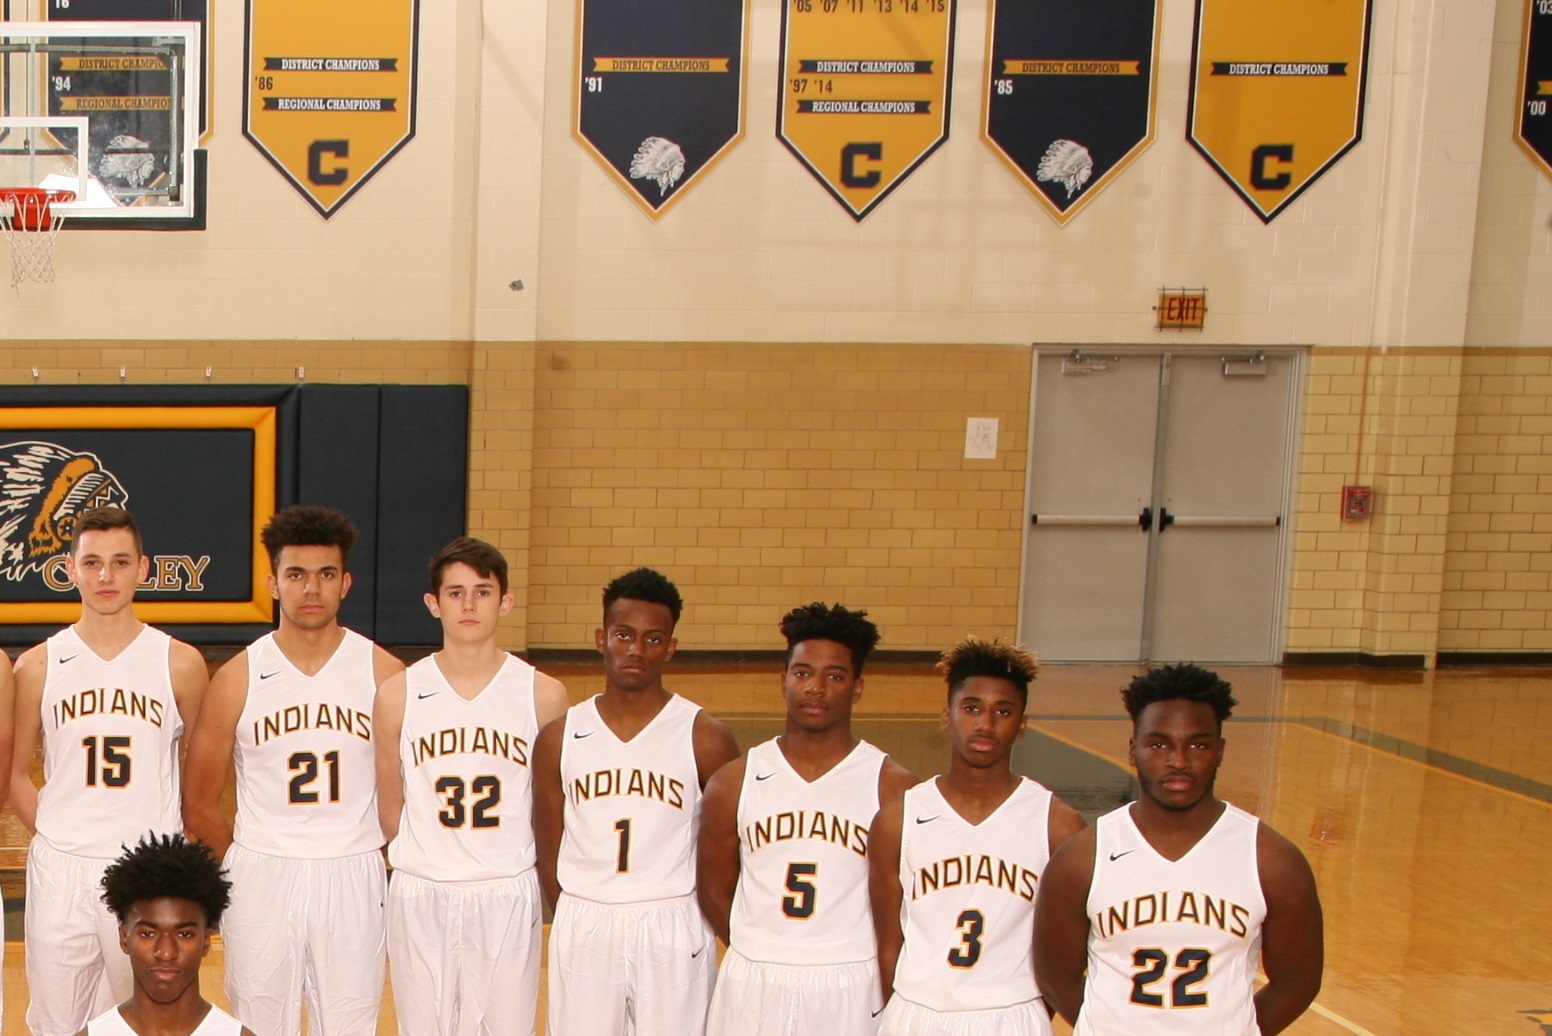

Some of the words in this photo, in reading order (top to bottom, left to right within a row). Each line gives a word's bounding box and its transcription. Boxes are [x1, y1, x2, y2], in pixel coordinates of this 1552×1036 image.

[794, 0, 811, 13] '05
[820, 0, 838, 13] '07
[847, 0, 863, 13] '11
[874, 0, 892, 13] '13
[900, 0, 918, 13] '14
[926, 0, 945, 13] '15
[78, 58, 121, 69] DISTRICT
[281, 58, 324, 70] DISTRICT
[325, 59, 380, 71] CHAMPIONS
[612, 60, 654, 71] DISTRICT
[655, 60, 710, 71] CHAMPIONS
[816, 61, 859, 72] DISTRICT
[860, 61, 915, 73] CHAMPIONS
[1022, 62, 1064, 73] DISTRICT
[1065, 63, 1121, 74] CHAMPIONS
[1229, 63, 1273, 74] DISTRICT
[1273, 63, 1329, 75] CHAMPIONS
[52, 76, 71, 91] '94
[255, 76, 273, 91] '86
[584, 76, 603, 92] '91
[789, 78, 808, 93] '97
[814, 79, 833, 94] '14
[994, 79, 1013, 95] '85
[76, 98, 123, 109] REGIONAL
[278, 98, 325, 110] REGIONAL
[326, 99, 381, 111] CHAMPIONS
[812, 101, 860, 112] REGIONAL
[860, 102, 915, 113] CHAMPIONS
[1527, 101, 1546, 115] '00
[308, 139, 349, 186] C
[840, 142, 883, 189] C
[1250, 143, 1294, 191] C
[1167, 298, 1200, 321] EXIT
[52, 687, 164, 732] INDIANS
[251, 703, 373, 748] INDIANS
[81, 735, 133, 790] 15
[411, 726, 530, 769] INDIANS
[286, 749, 342, 806] 21
[568, 767, 686, 811] INDIANS
[434, 774, 503, 831] 32
[612, 817, 633, 876] 1
[746, 810, 869, 860] INDIANS
[781, 861, 820, 922] 5
[911, 854, 1040, 904] INDIANS
[1096, 890, 1250, 940] INDIANS
[946, 907, 987, 971] 3
[1127, 945, 1214, 1011] 22
